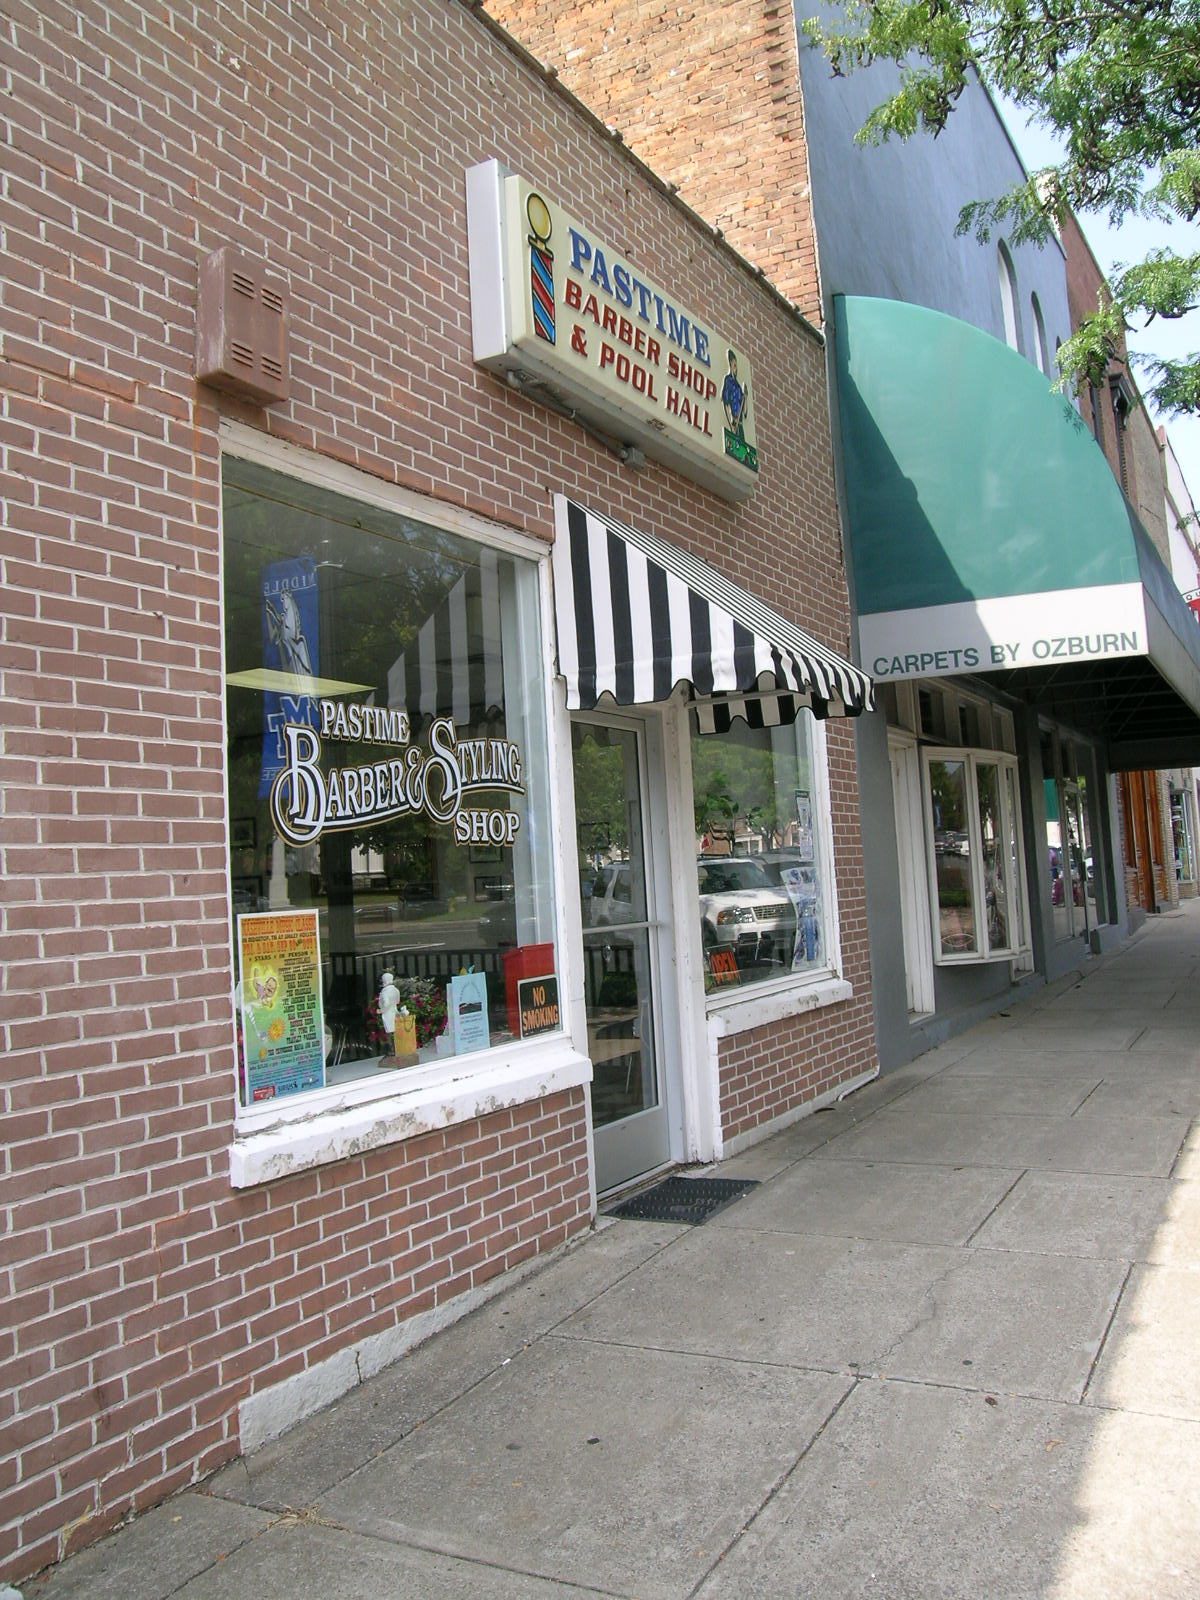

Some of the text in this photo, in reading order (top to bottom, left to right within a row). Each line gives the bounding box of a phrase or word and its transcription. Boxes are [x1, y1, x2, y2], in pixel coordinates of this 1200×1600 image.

[568, 226, 712, 368] PASTIME
[564, 277, 717, 401] BARBER SHOP
[570, 324, 713, 438] & POOL HALL
[873, 631, 1138, 676] CARPETS BY OZBURN
[320, 700, 410, 746] PASTIME
[271, 718, 523, 848] BARBER & STYLING
[454, 807, 521, 846] SHOP
[522, 1004, 559, 1031] SMOKING
[533, 986, 546, 1007] NO
